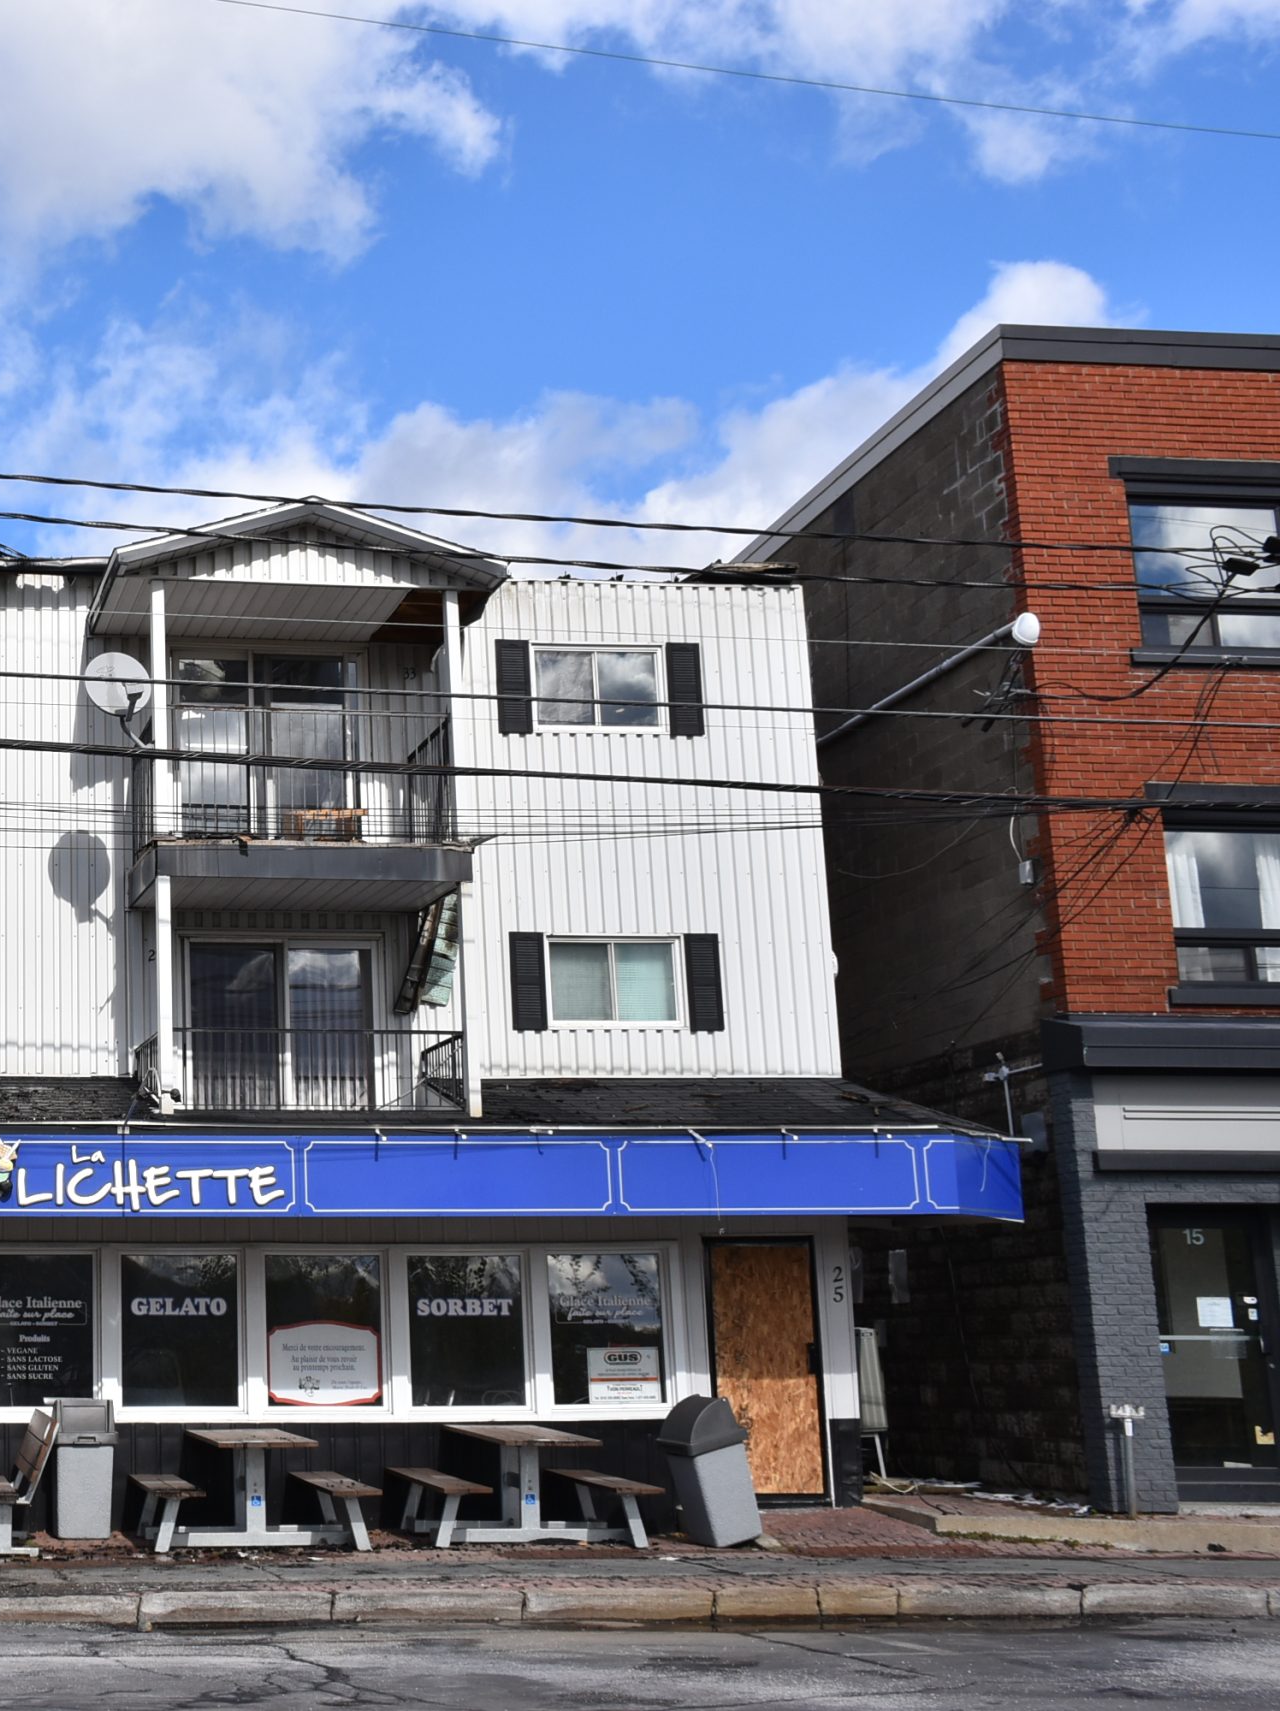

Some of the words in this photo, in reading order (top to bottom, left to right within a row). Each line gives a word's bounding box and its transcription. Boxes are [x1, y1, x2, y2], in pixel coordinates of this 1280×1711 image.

[71, 1144, 106, 1163] La
[17, 1158, 286, 1212] LICHETTE
[1182, 1228, 1205, 1245] 15
[26, 1296, 82, 1308] Italienne
[560, 1296, 595, 1307] Glace
[598, 1295, 651, 1306] Italienne
[130, 1297, 228, 1316] GELATO
[416, 1298, 513, 1317] SORBET
[22, 1311, 42, 1319] sur
[42, 1307, 75, 1323] place
[19, 1334, 50, 1342] Produits
[7, 1346, 38, 1354] VEGANE
[282, 1344, 299, 1352] Merci
[300, 1344, 307, 1352] de
[6, 1355, 27, 1363] SANS
[28, 1355, 63, 1363] LACTOSE
[291, 1355, 300, 1363] Au
[319, 1355, 326, 1363] de
[607, 1353, 639, 1362] GUS
[6, 1364, 27, 1372] SANS
[28, 1364, 59, 1372] GLUTEN
[6, 1372, 27, 1380] SANS
[28, 1372, 54, 1380] SUCRE
